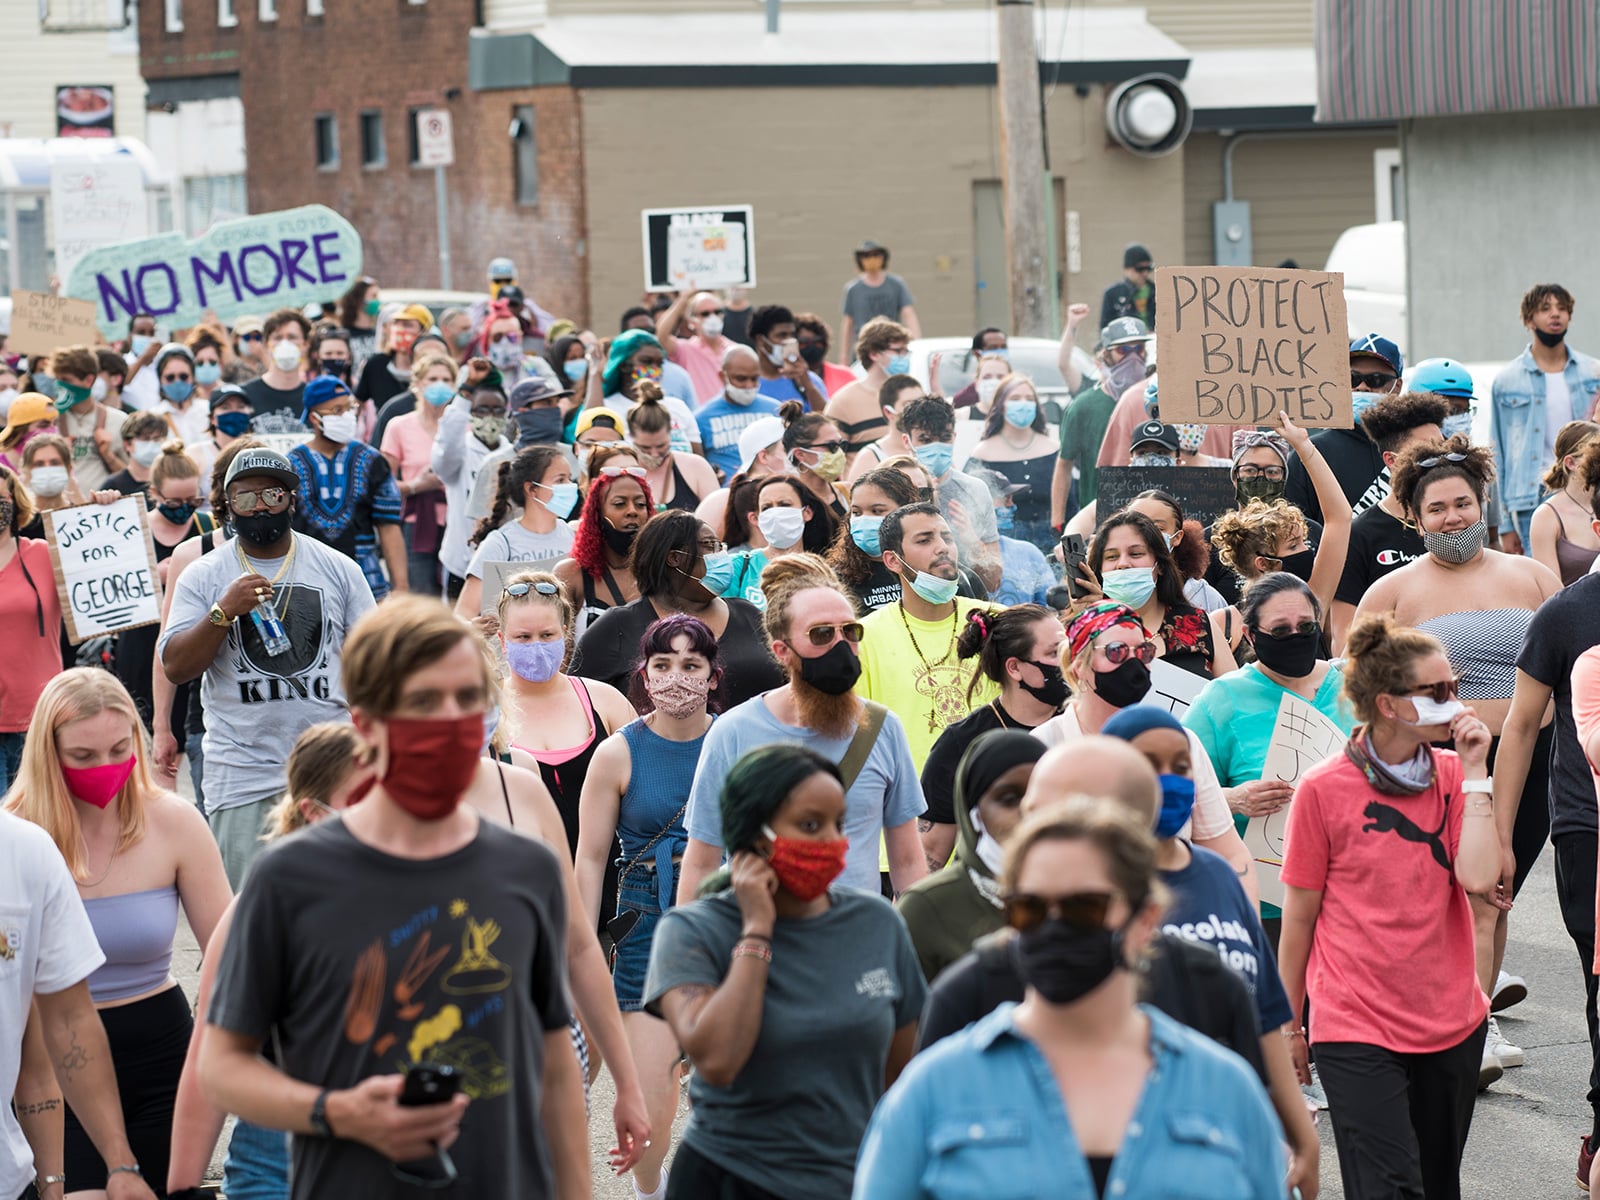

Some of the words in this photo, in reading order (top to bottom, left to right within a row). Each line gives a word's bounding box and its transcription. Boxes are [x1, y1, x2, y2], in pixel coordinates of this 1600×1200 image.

[96, 262, 181, 322] NO
[190, 232, 346, 308] MORE
[28, 292, 68, 310] STOP
[1172, 275, 1331, 335] PROTECT
[1201, 332, 1318, 379] BLACK
[1196, 379, 1337, 423] BODIES
[57, 512, 140, 548] JUSTICE
[82, 545, 117, 562] FOR
[72, 569, 154, 614] GEORGE
[863, 590, 901, 607] URBAN
[871, 583, 901, 594] MINNE
[238, 675, 330, 704] KING
